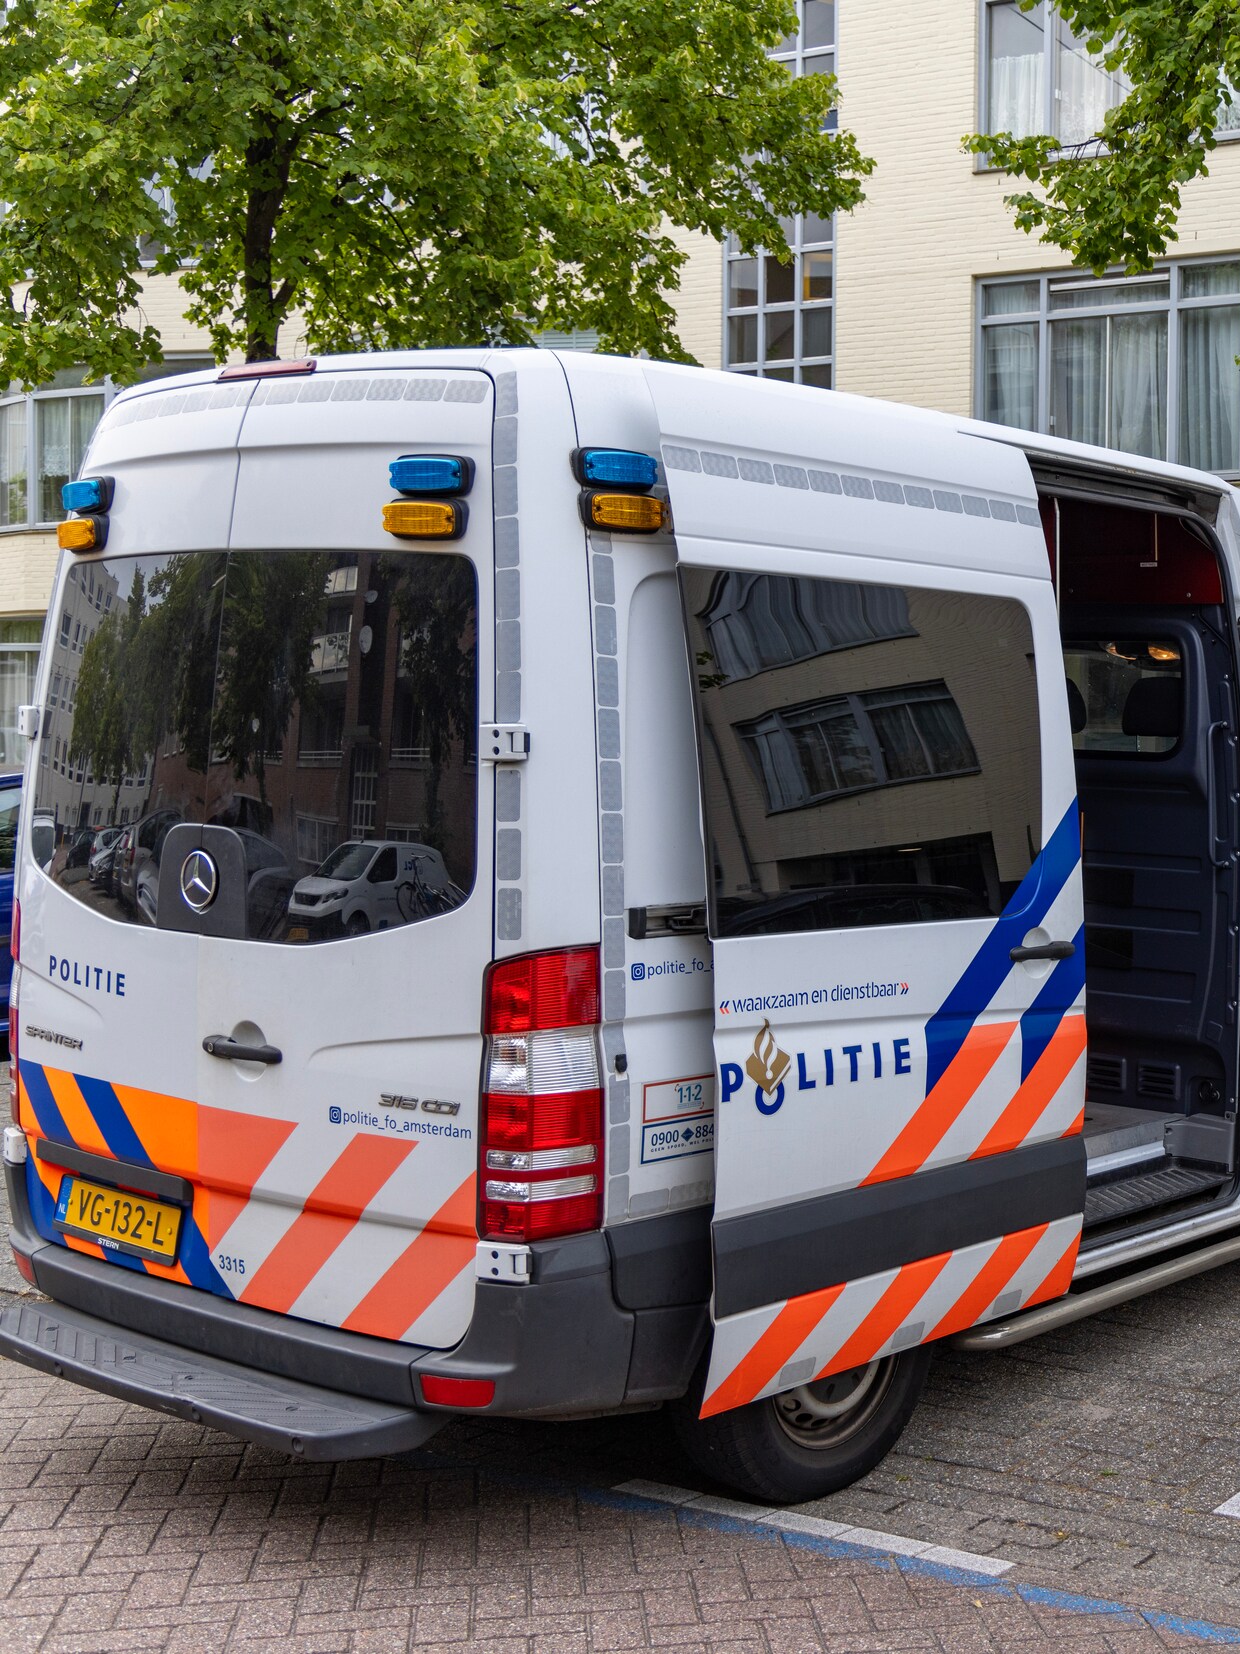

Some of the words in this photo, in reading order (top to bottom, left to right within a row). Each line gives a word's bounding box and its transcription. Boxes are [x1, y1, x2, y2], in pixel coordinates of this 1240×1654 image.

[50, 955, 125, 996] POLITIE
[811, 988, 828, 1004] en
[25, 1024, 83, 1051] SPRINTER
[720, 1037, 911, 1115] POLITIE
[378, 1092, 418, 1110] 316
[420, 1098, 460, 1116] CDI
[343, 1110, 472, 1139] politie_fo_amsterdam
[651, 1129, 680, 1146] 0900
[58, 1203, 66, 1215] NL
[79, 1188, 165, 1247] VG-132-L
[97, 1237, 120, 1250] STERN
[218, 1254, 246, 1275] 3315
